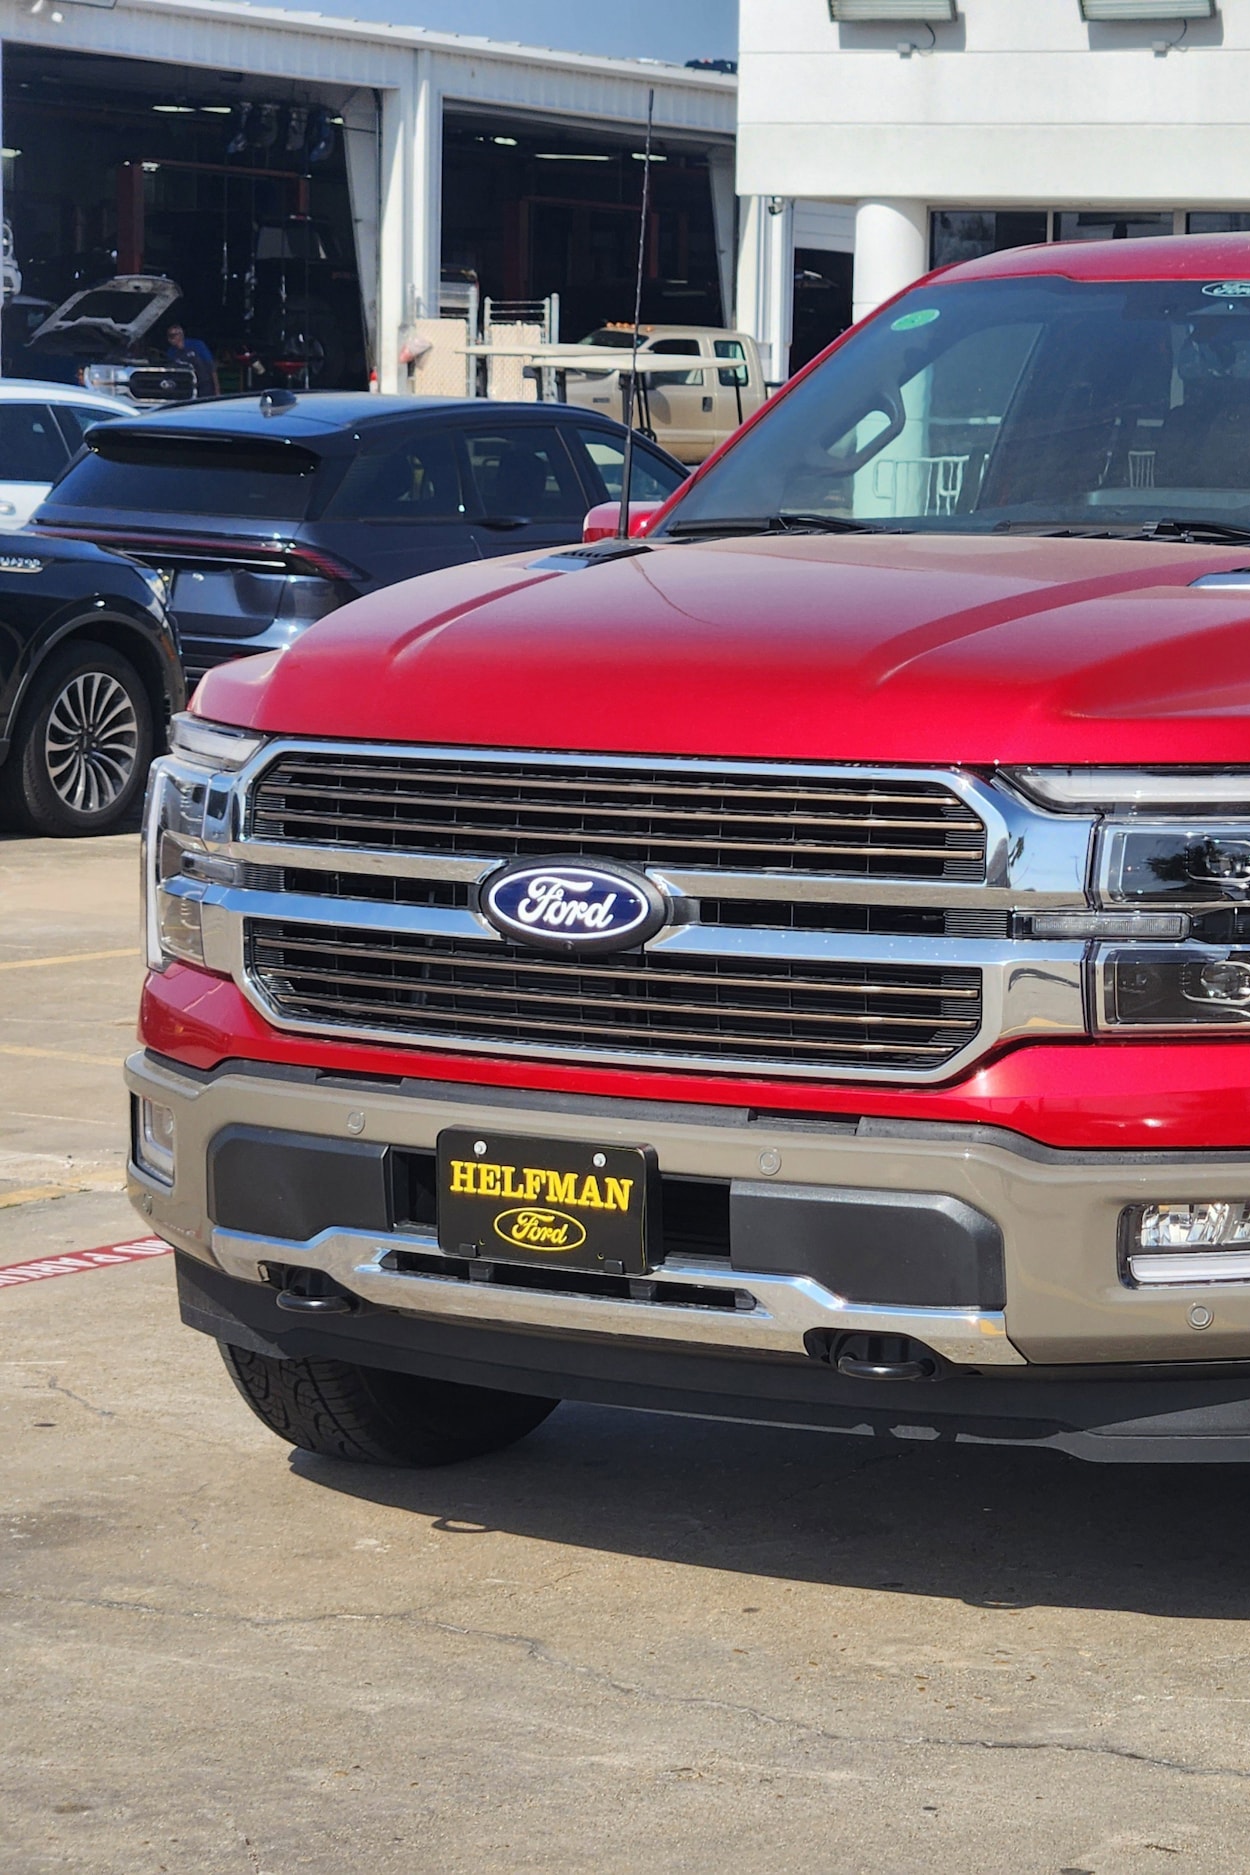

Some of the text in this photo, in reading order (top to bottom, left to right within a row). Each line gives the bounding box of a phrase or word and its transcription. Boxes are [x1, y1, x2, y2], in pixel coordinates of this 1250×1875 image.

[517, 876, 617, 928] Ford
[449, 1160, 634, 1212] HELFMAN
[511, 1211, 568, 1244] Ford
